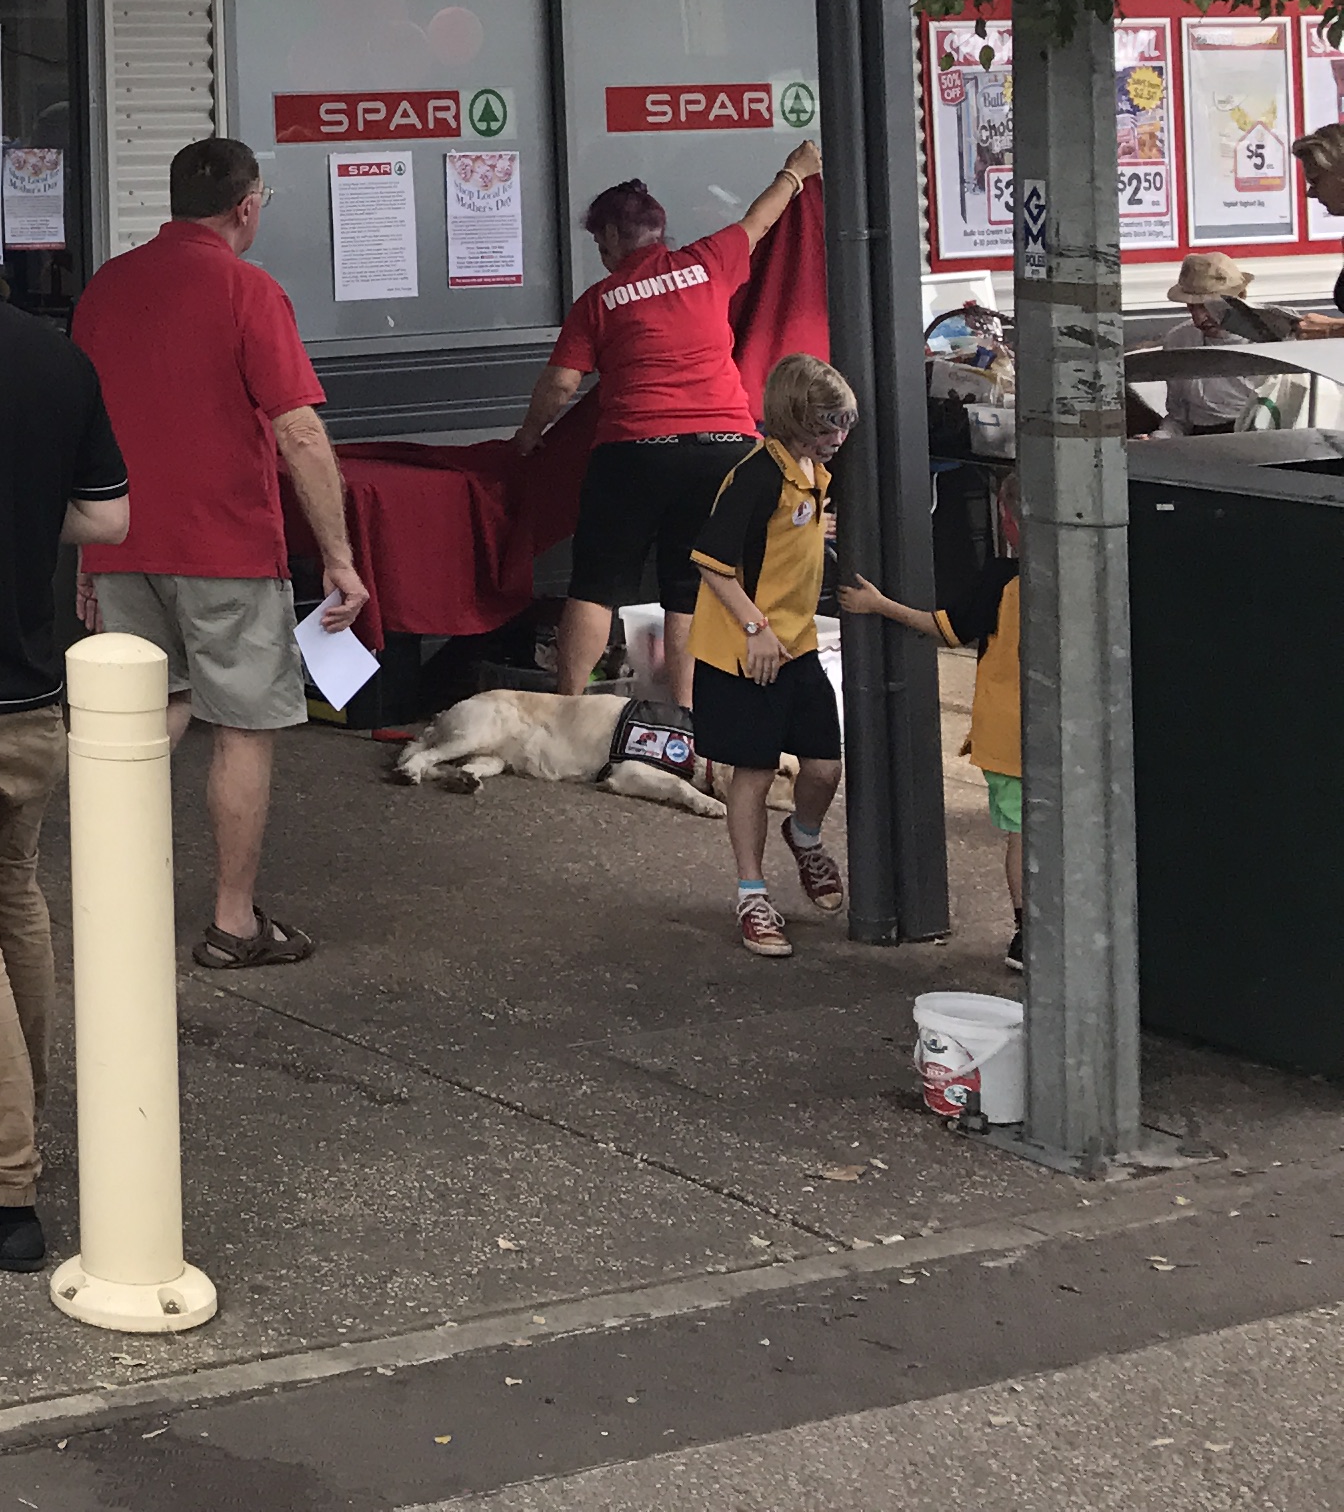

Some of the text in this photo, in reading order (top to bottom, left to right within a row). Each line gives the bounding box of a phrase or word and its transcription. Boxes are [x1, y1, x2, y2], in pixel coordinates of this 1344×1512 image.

[941, 73, 962, 89] 50%
[944, 88, 962, 100] OFF
[318, 97, 458, 134] SPAR
[644, 90, 771, 123] SPAR
[1246, 143, 1266, 170] $5
[348, 164, 391, 176] SPAR
[476, 188, 501, 201] Local
[602, 264, 710, 311] VOLUNTEER
